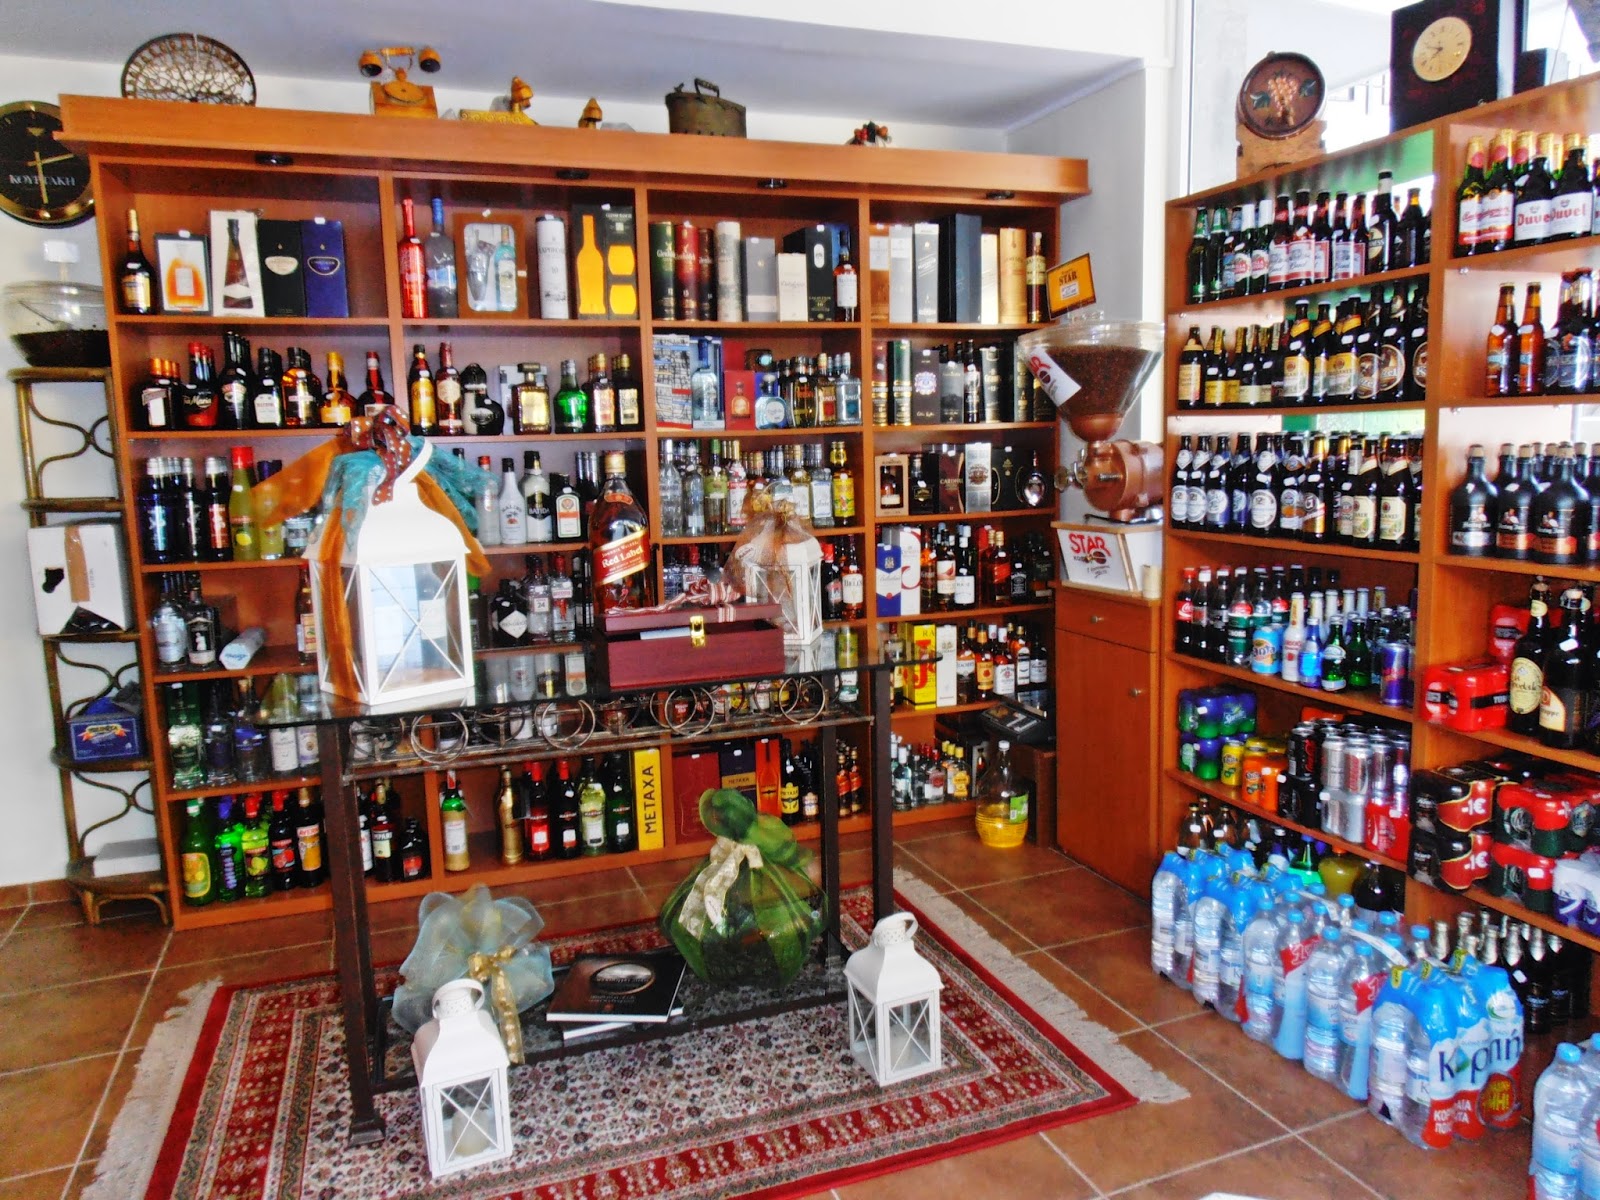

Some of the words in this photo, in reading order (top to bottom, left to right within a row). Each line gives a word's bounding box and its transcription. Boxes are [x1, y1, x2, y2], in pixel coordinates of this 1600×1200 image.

[1518, 213, 1551, 226] Duve
[1551, 203, 1587, 220] Duvel
[1059, 271, 1078, 286] STAR
[602, 553, 620, 568] Red
[620, 544, 645, 562] Label
[642, 765, 657, 834] METAXA
